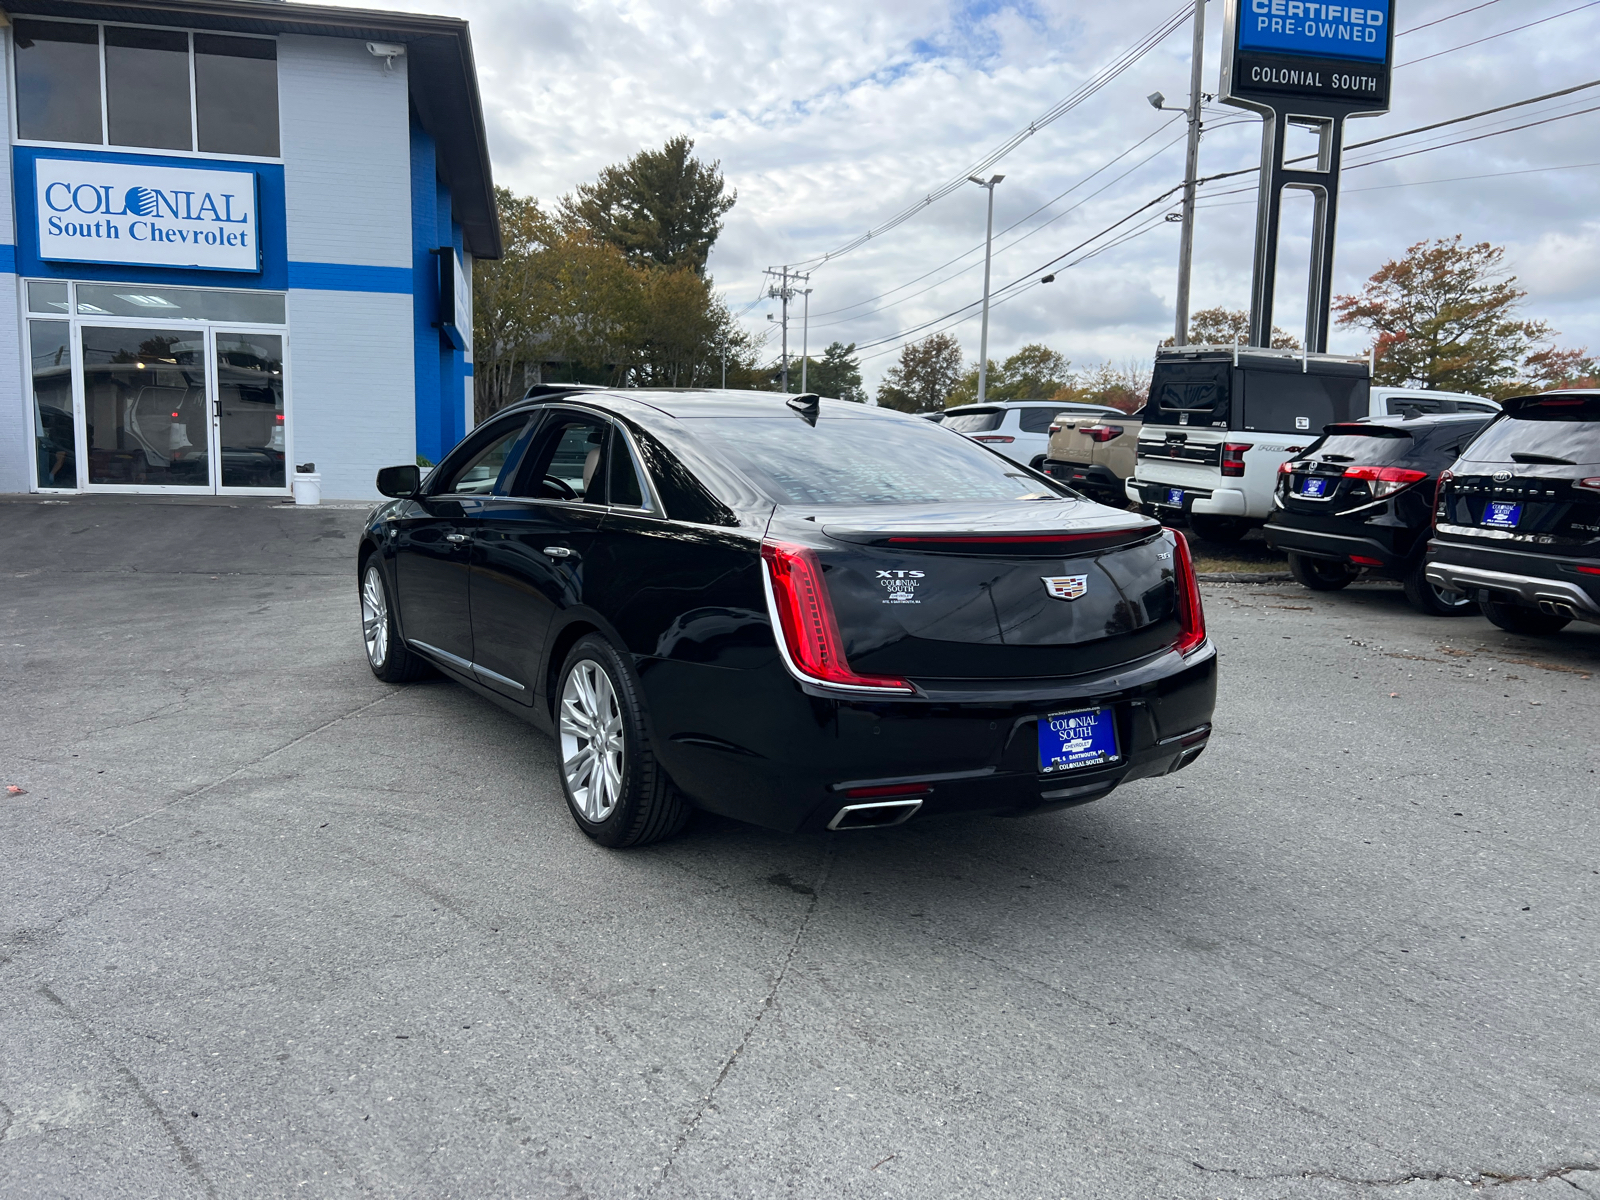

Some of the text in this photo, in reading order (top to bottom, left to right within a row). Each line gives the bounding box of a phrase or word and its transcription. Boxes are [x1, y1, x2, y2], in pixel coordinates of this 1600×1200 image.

[1252, 0, 1384, 26] CERTIFIED
[1257, 16, 1377, 43] PRE-OWNED
[1251, 66, 1377, 92] COLONIAL SOUTH
[45, 182, 248, 224] COLONIAL
[48, 215, 248, 247] South Chevrolet
[1454, 485, 1555, 496] TELLURIDE
[875, 570, 925, 579] XTS
[881, 579, 920, 587] COLONIAL
[1050, 715, 1098, 731] COLONIAL
[1059, 726, 1092, 740] SOUTH
[1065, 741, 1090, 750] CHEVROLET
[1086, 757, 1104, 766] SOUTH
